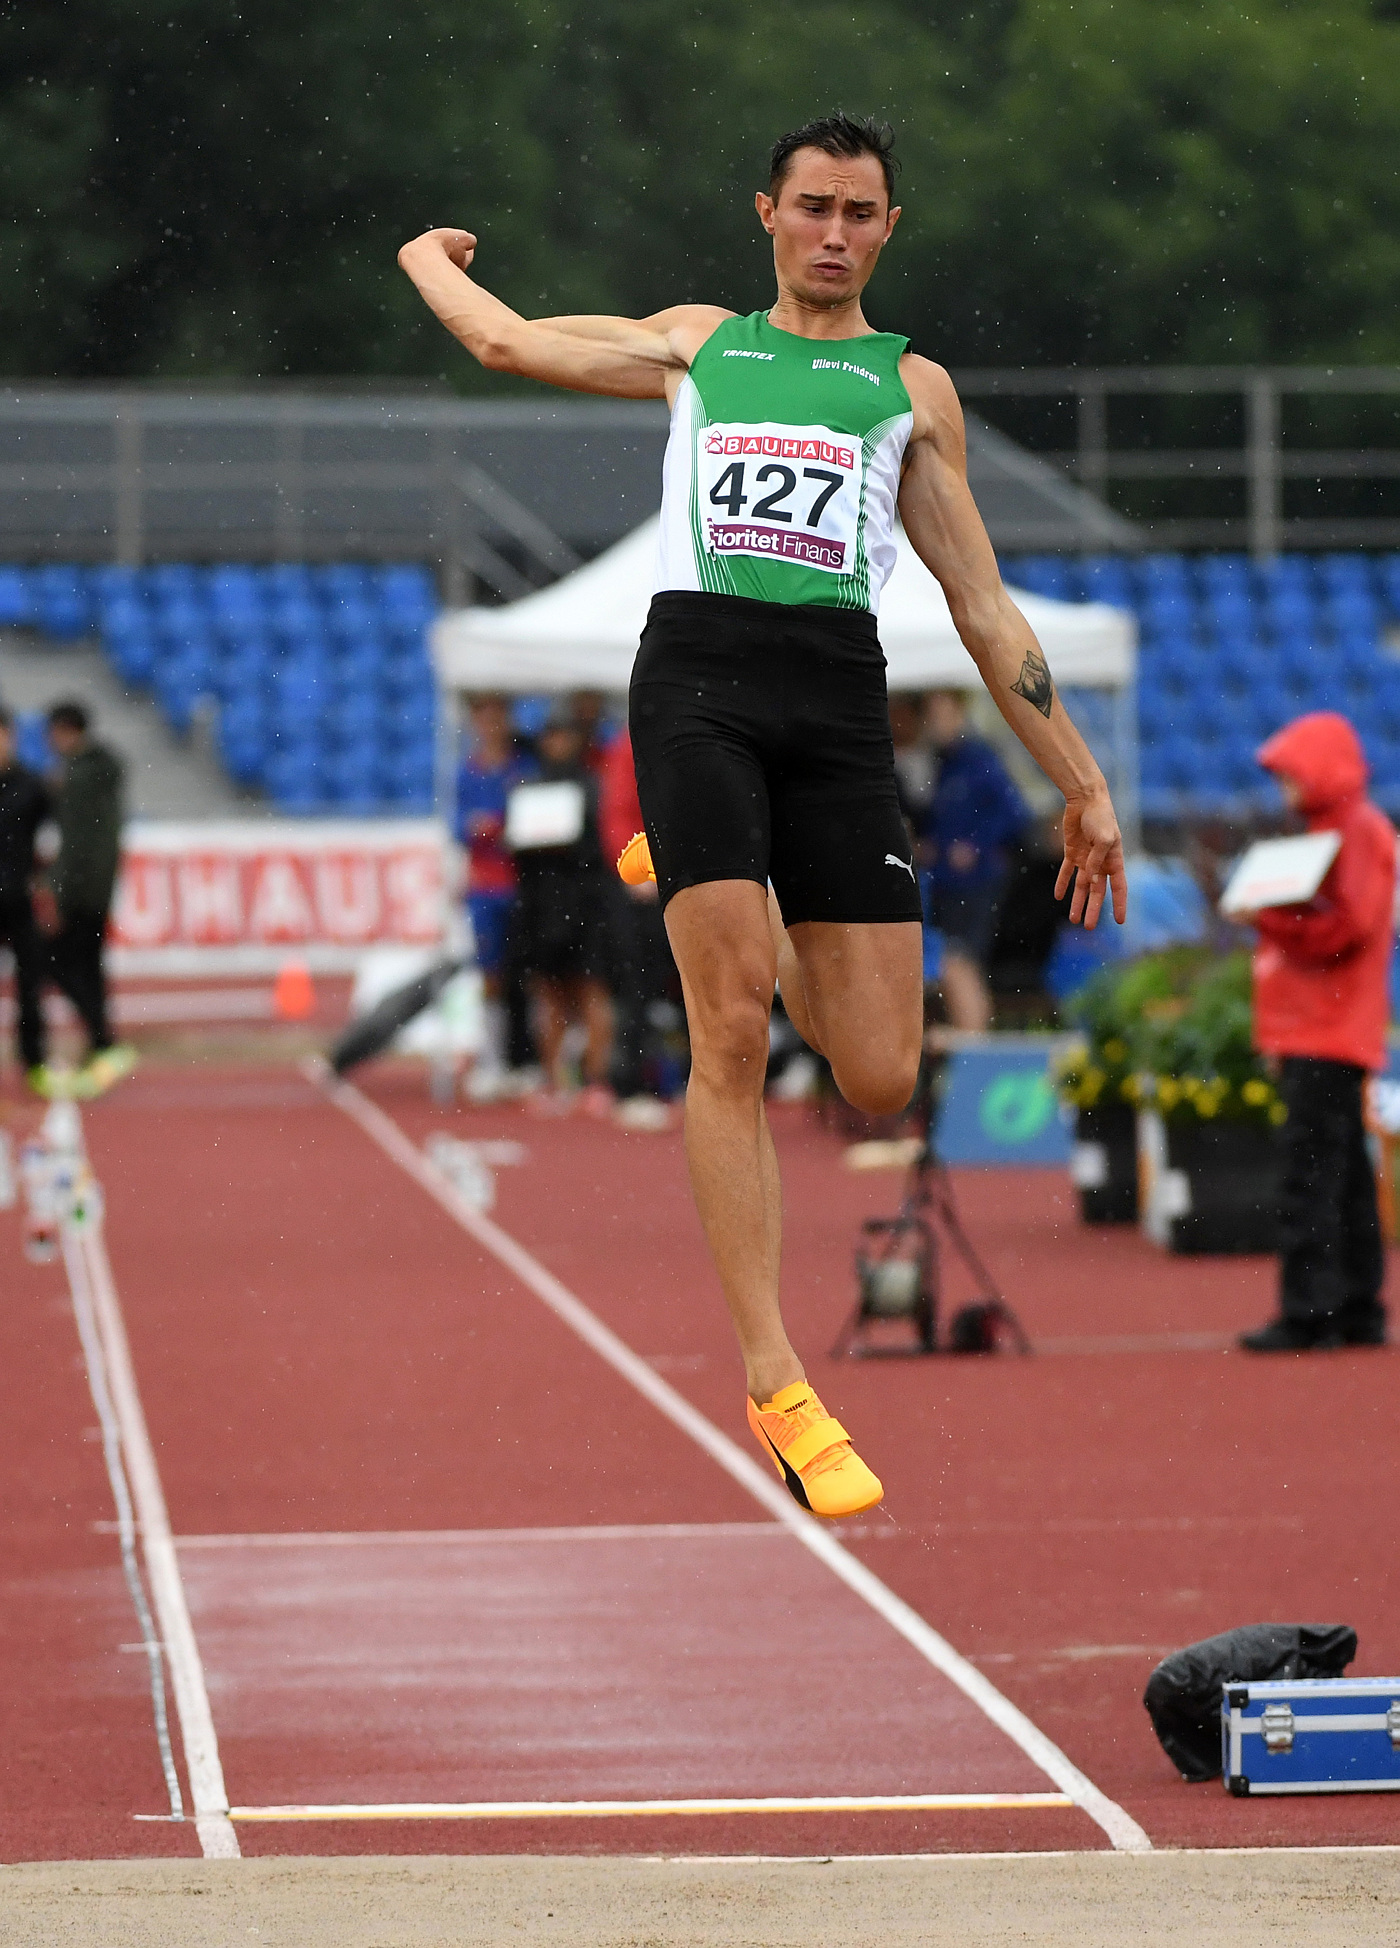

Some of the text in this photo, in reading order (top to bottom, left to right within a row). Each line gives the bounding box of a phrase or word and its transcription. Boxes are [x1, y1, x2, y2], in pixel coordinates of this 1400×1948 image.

[722, 350, 775, 361] TRIMTEX
[812, 358, 840, 370] Ullevi
[725, 437, 852, 466] BAUHAUS
[709, 462, 844, 528] 427
[713, 528, 842, 566] ioritet Finans
[110, 851, 446, 942] UHAUS
